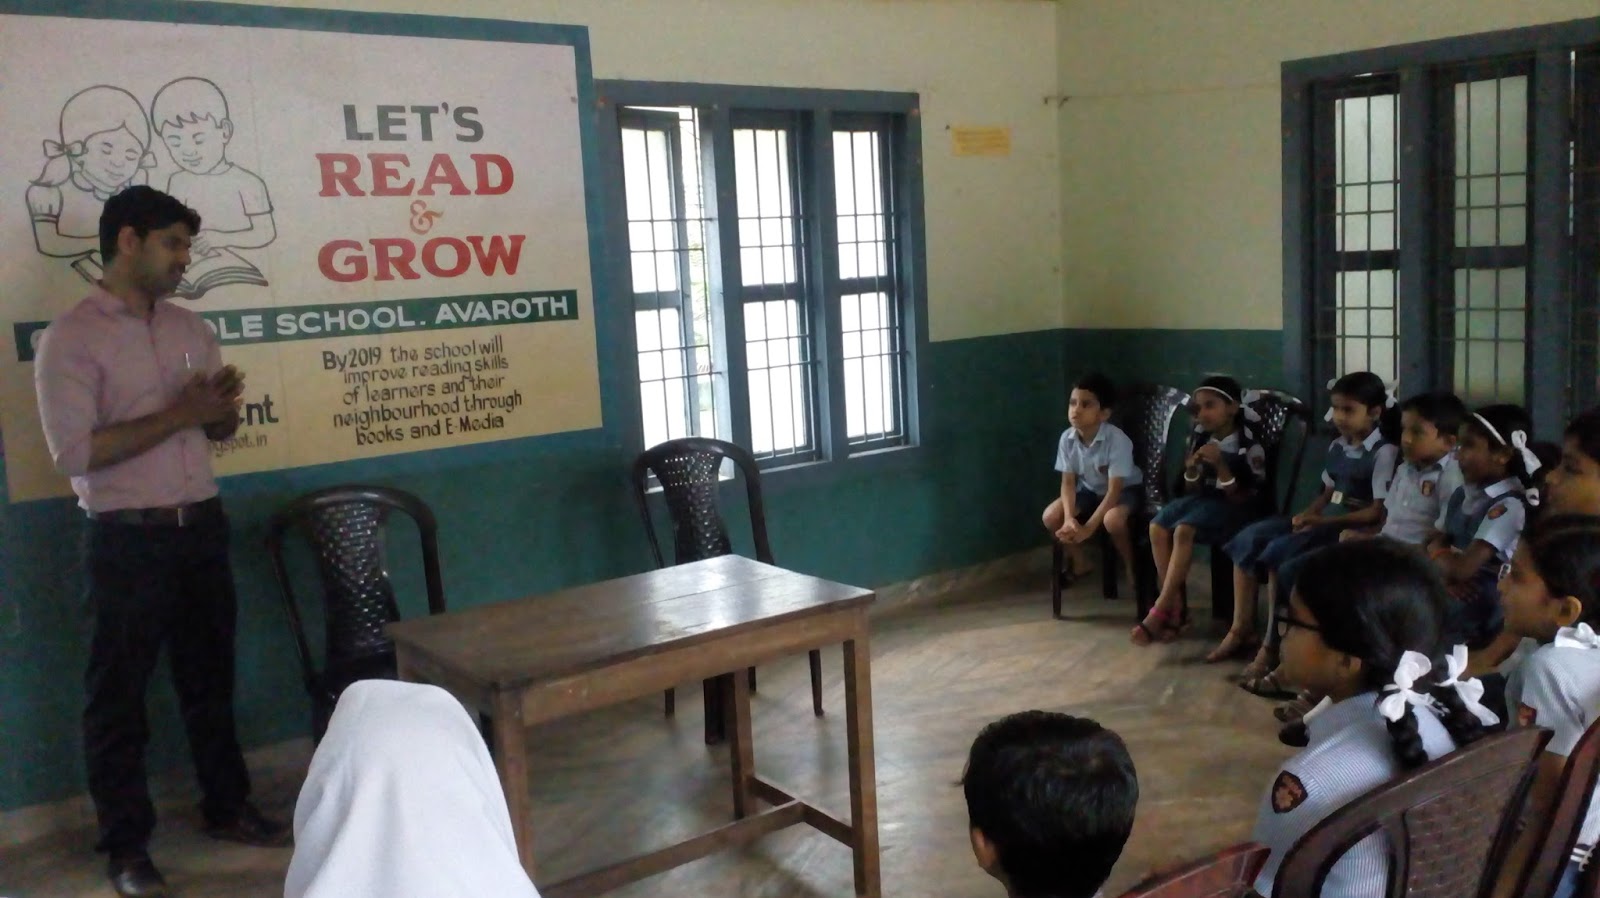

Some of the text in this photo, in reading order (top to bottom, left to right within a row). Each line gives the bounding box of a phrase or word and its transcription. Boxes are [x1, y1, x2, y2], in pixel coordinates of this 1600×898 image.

[343, 102, 484, 143] LET'S
[315, 153, 514, 197] READ
[410, 200, 443, 235] &
[317, 235, 526, 283] GROW
[435, 296, 569, 325] AVAROTH
[390, 345, 418, 363] the
[424, 339, 476, 360] school
[479, 334, 503, 354] will
[343, 355, 509, 387] improve reading skills
[343, 375, 505, 405] of learners and their
[333, 389, 522, 430] neighbourhood through
[356, 424, 404, 445] books
[410, 419, 441, 439] and
